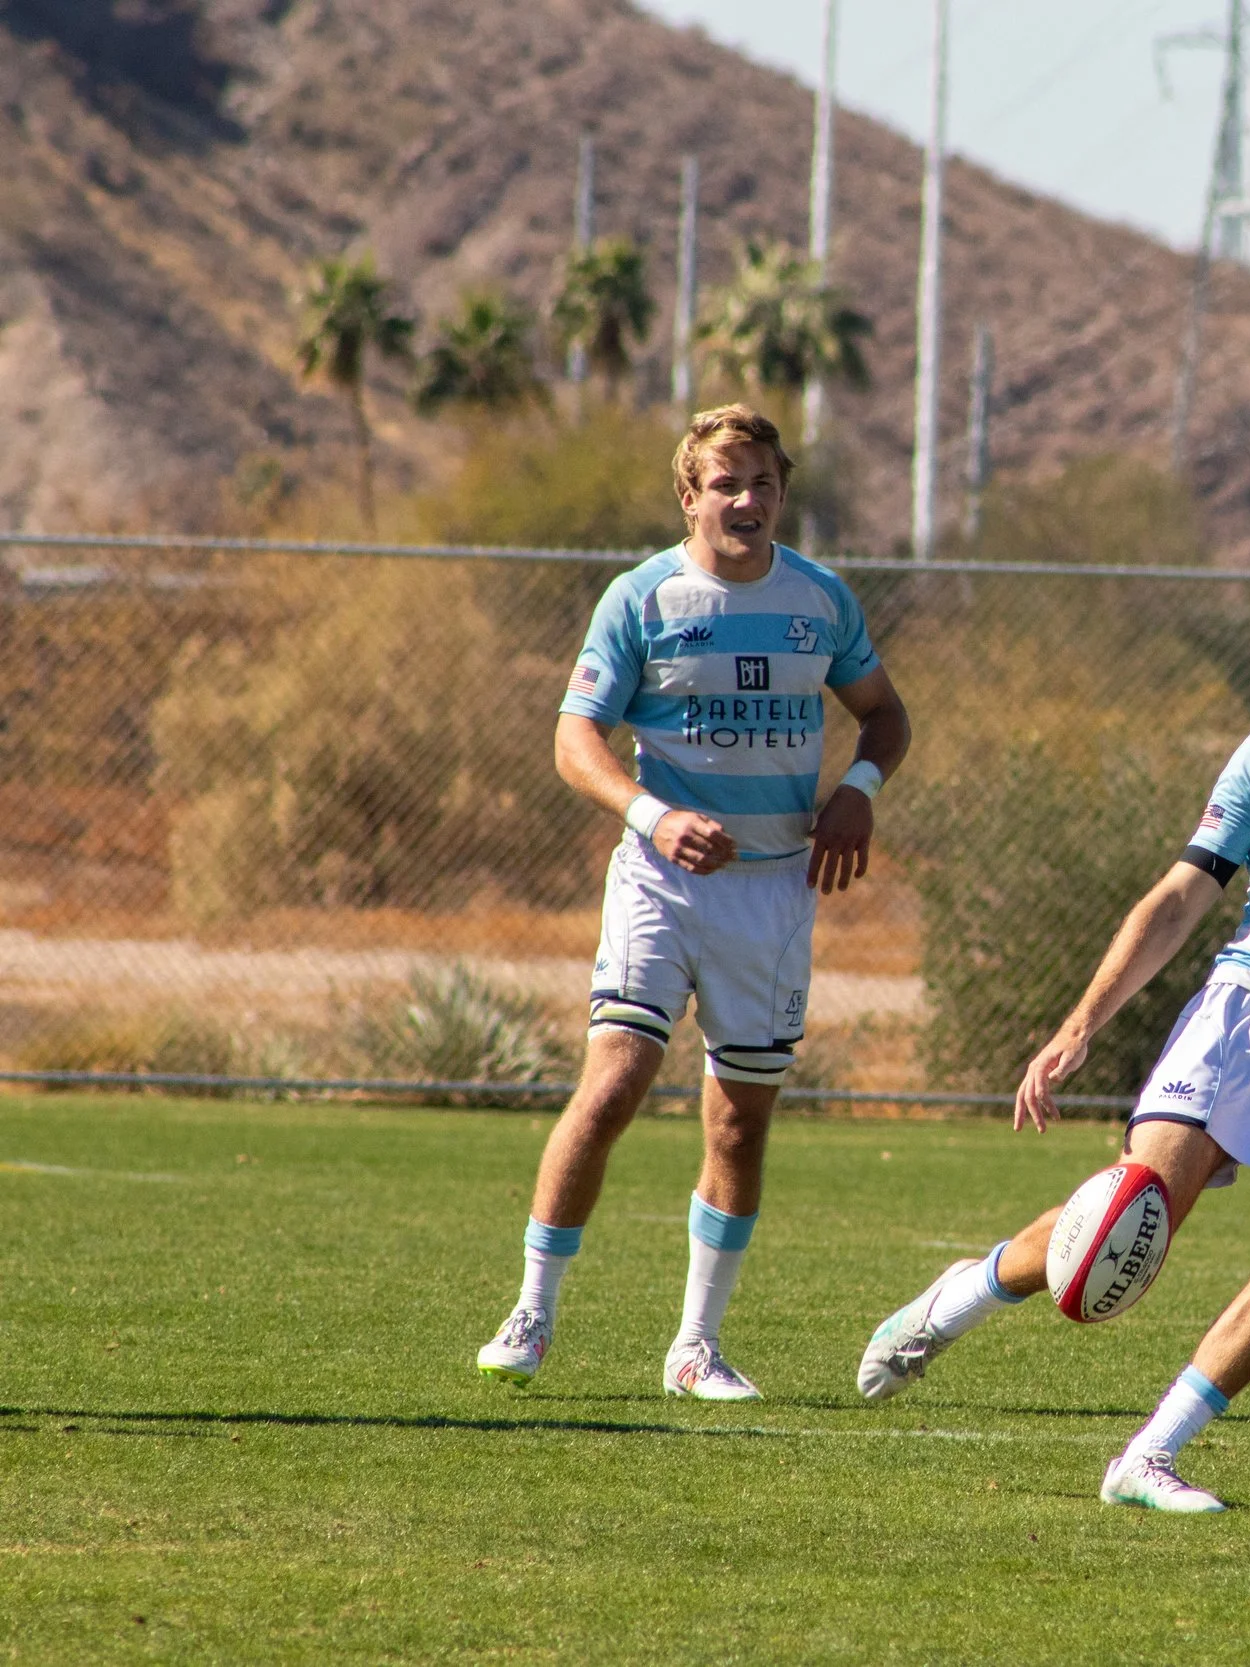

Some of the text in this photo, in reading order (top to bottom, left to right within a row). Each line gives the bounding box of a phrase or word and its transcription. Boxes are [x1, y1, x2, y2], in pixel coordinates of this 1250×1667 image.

[741, 661, 765, 687] BH
[687, 695, 808, 720] BARTELL
[687, 721, 807, 748] HOTELS
[1060, 1214, 1085, 1263] SHOP
[1092, 1201, 1161, 1314] GILBERT
